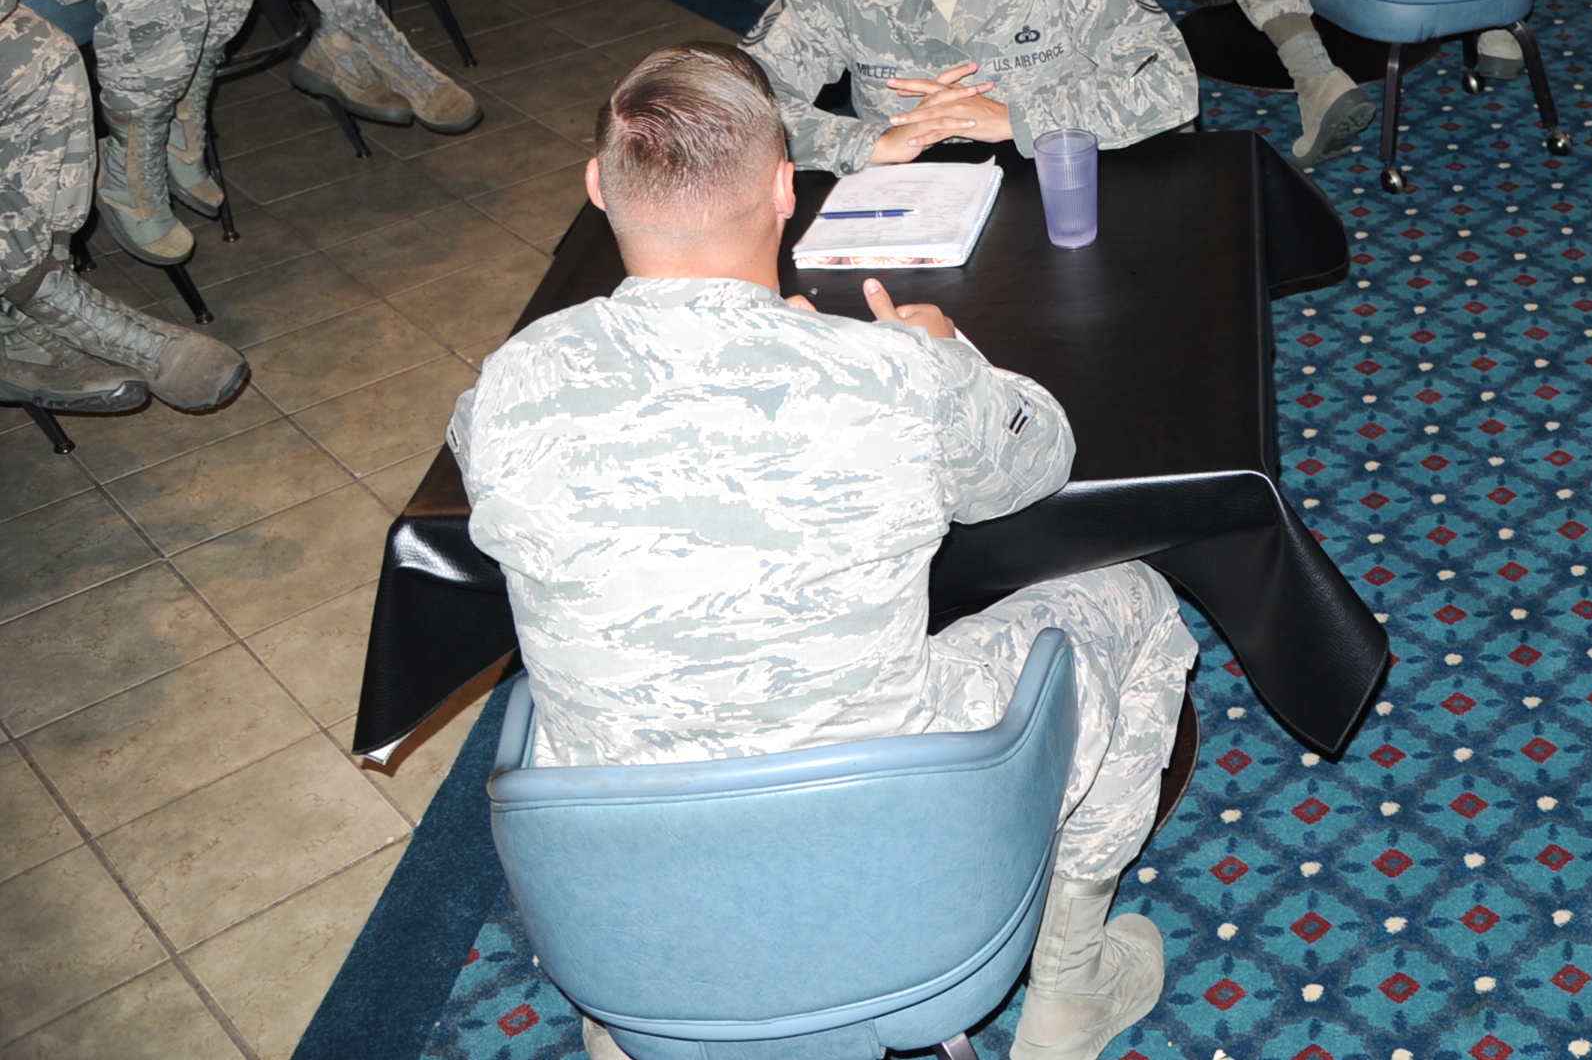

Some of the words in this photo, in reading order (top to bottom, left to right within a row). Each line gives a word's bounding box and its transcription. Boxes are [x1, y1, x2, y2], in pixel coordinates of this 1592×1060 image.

[993, 57, 1012, 72] U.S.
[1014, 54, 1033, 70] AIR
[1033, 42, 1065, 67] FORCE
[856, 61, 898, 79] MILLER
